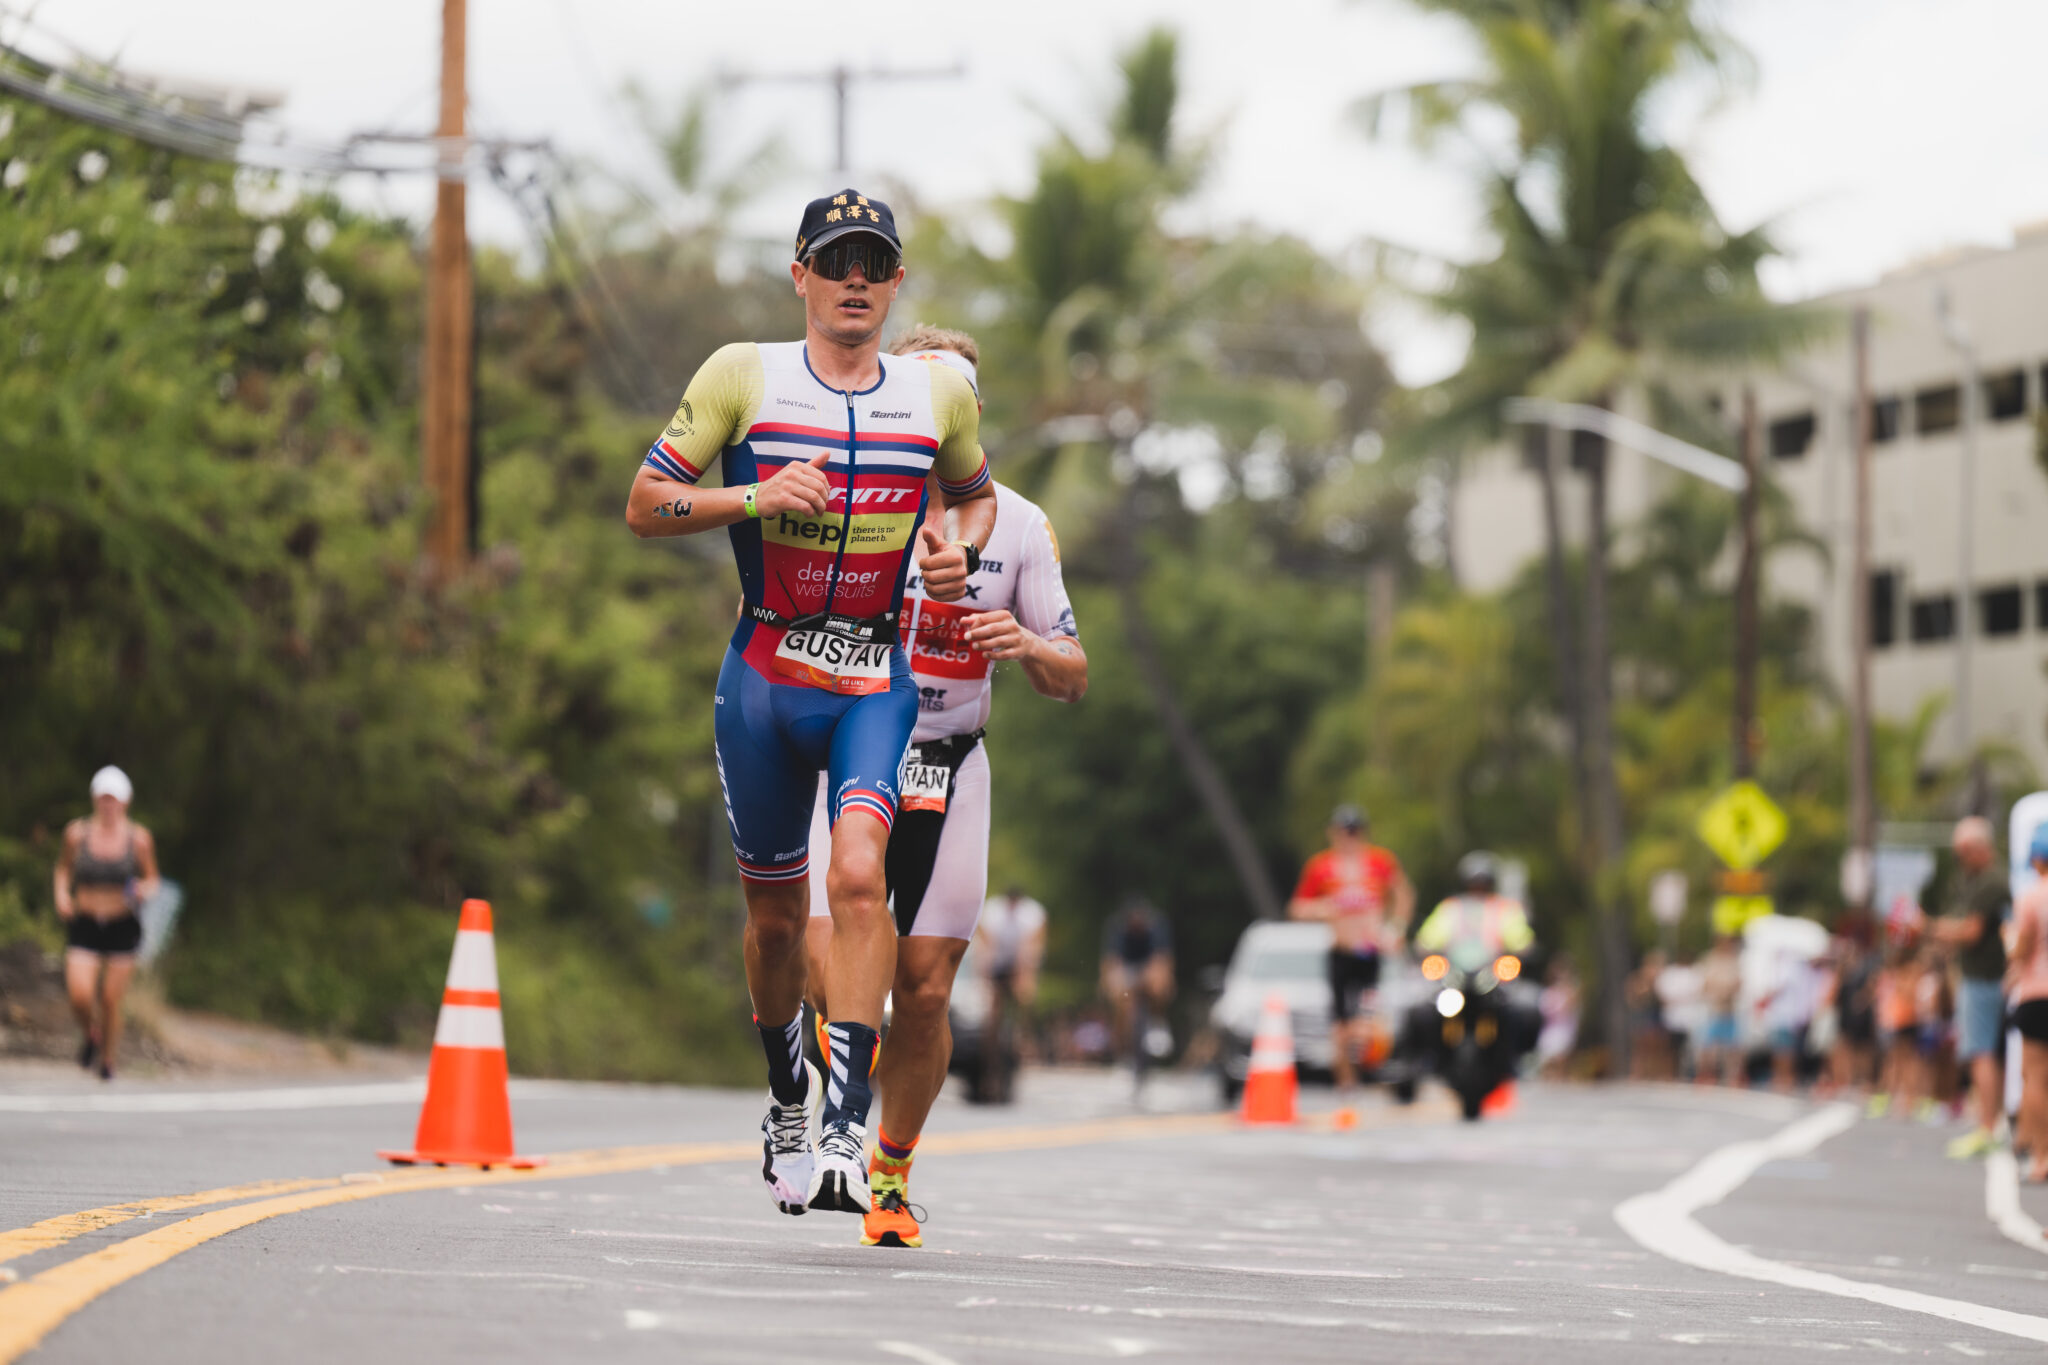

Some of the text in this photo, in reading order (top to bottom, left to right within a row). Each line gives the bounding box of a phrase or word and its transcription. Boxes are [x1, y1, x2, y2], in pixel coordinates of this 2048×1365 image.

[776, 397, 817, 411] SANTARA
[870, 410, 912, 420] Santini
[829, 486, 916, 504] ANT
[780, 512, 842, 545] hep
[852, 526, 876, 534] there
[877, 525, 885, 534] is
[851, 534, 881, 544] planet
[797, 561, 881, 584] deboer
[795, 582, 876, 599] wetsuits
[785, 631, 890, 668] GUSTAV
[917, 686, 948, 699] er
